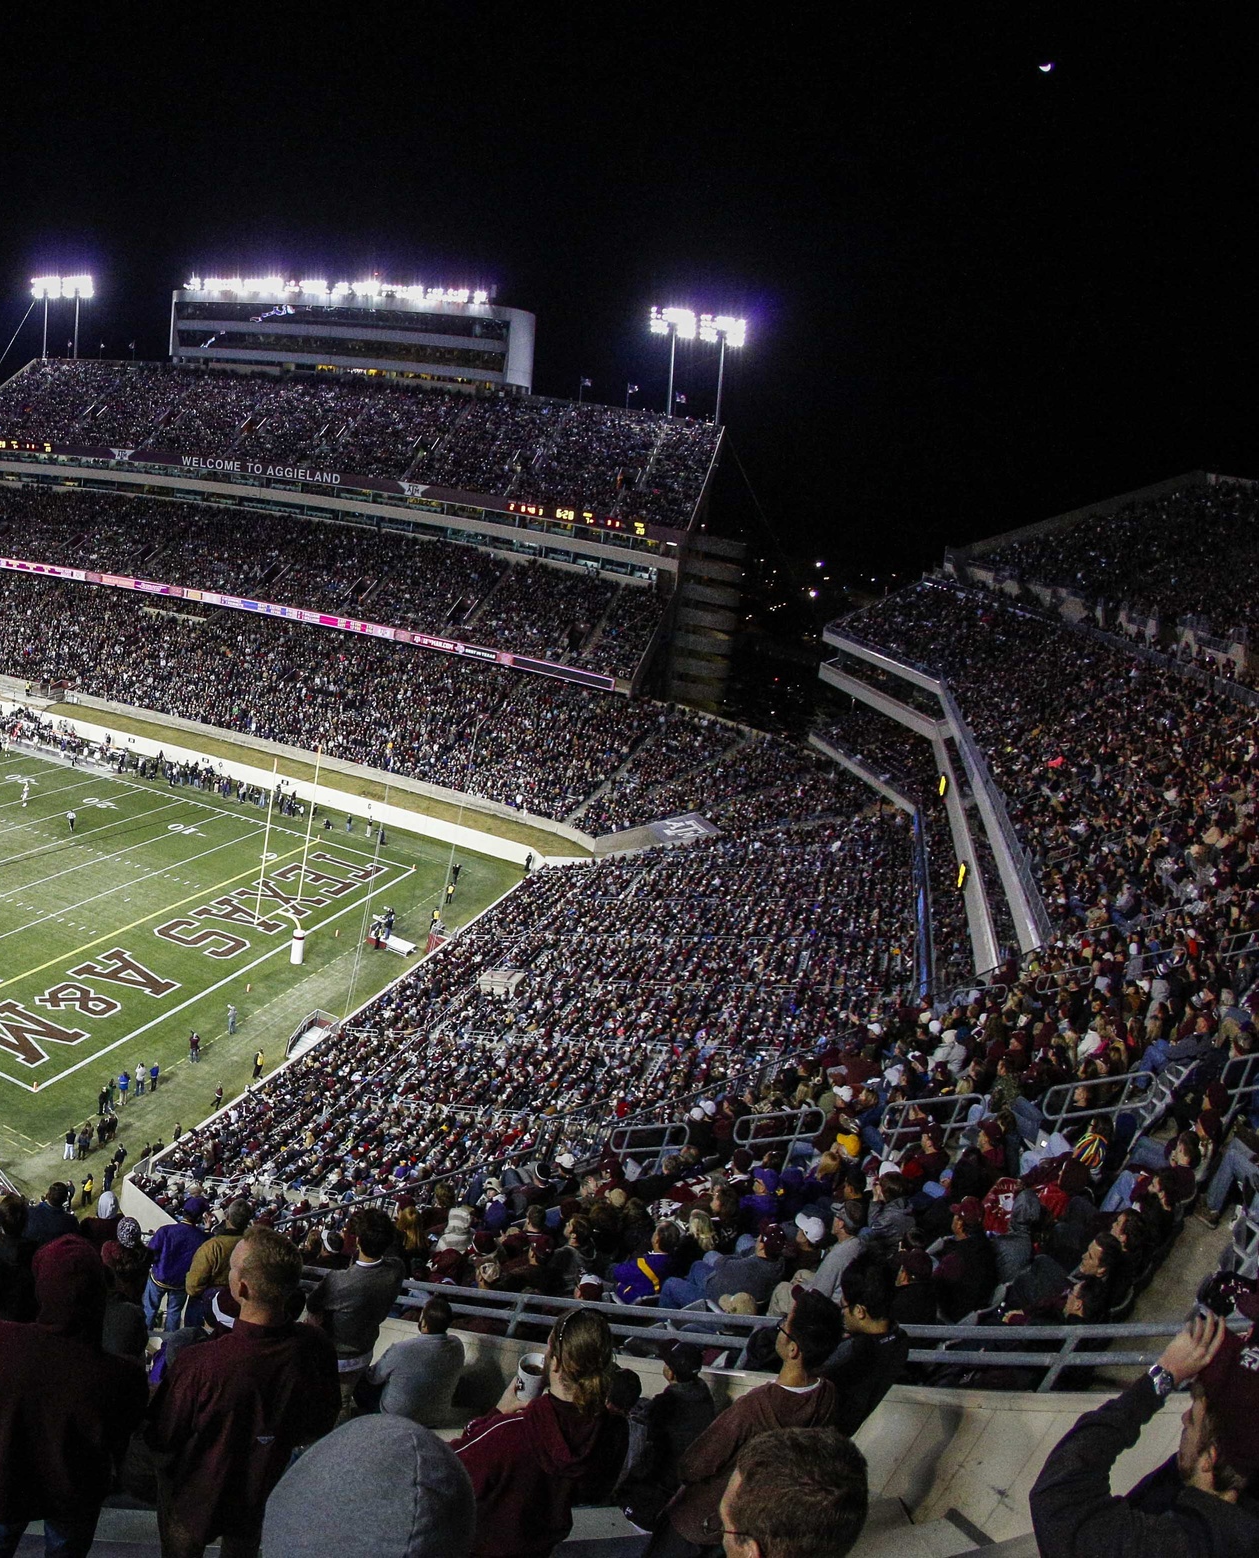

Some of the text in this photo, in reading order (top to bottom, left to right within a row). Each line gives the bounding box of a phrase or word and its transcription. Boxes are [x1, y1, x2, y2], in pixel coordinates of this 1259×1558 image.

[181, 455, 341, 484] WELCOME TO AGGIELAND
[167, 823, 199, 835] 10
[153, 851, 389, 959] TEXAS
